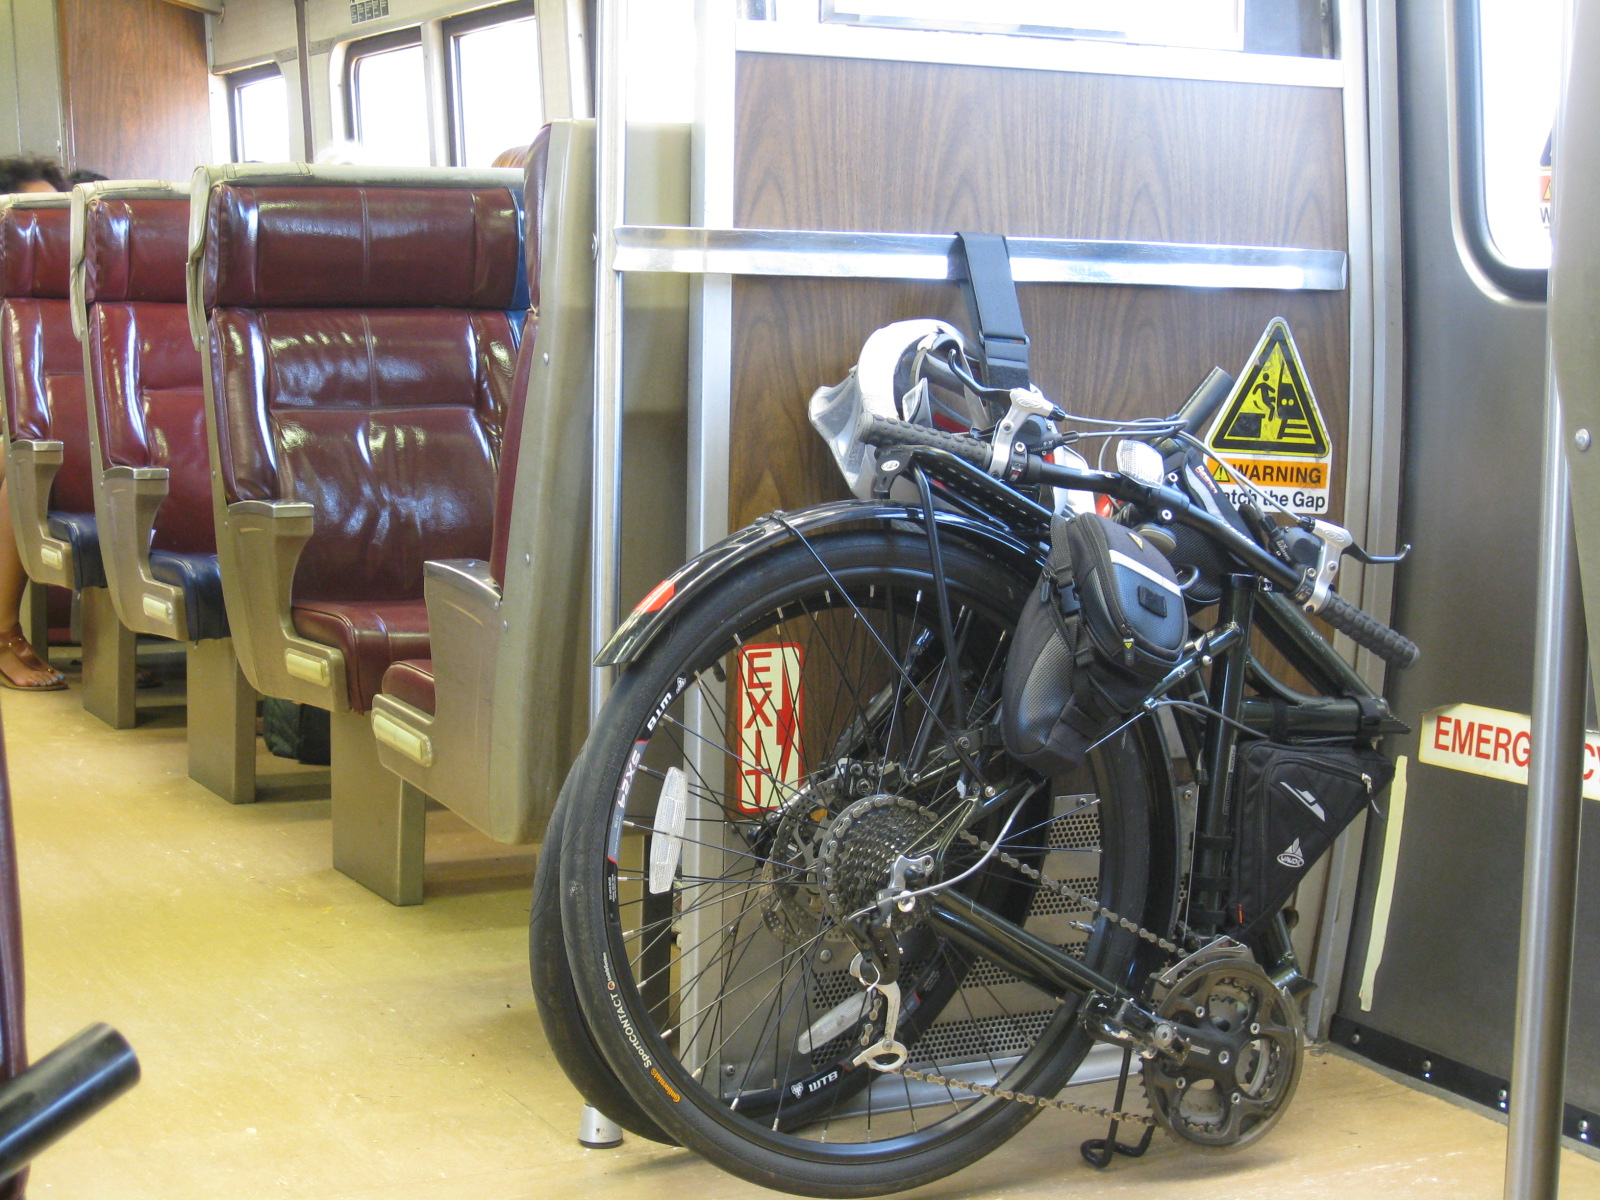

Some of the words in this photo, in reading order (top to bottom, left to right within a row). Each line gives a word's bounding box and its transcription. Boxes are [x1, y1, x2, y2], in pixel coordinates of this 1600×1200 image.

[1232, 463, 1321, 484] WARNING
[1263, 490, 1288, 507] the
[1292, 490, 1326, 512] Gap
[646, 692, 672, 732] WTB
[743, 651, 773, 806] EXIT
[808, 1070, 838, 1093] WTB
